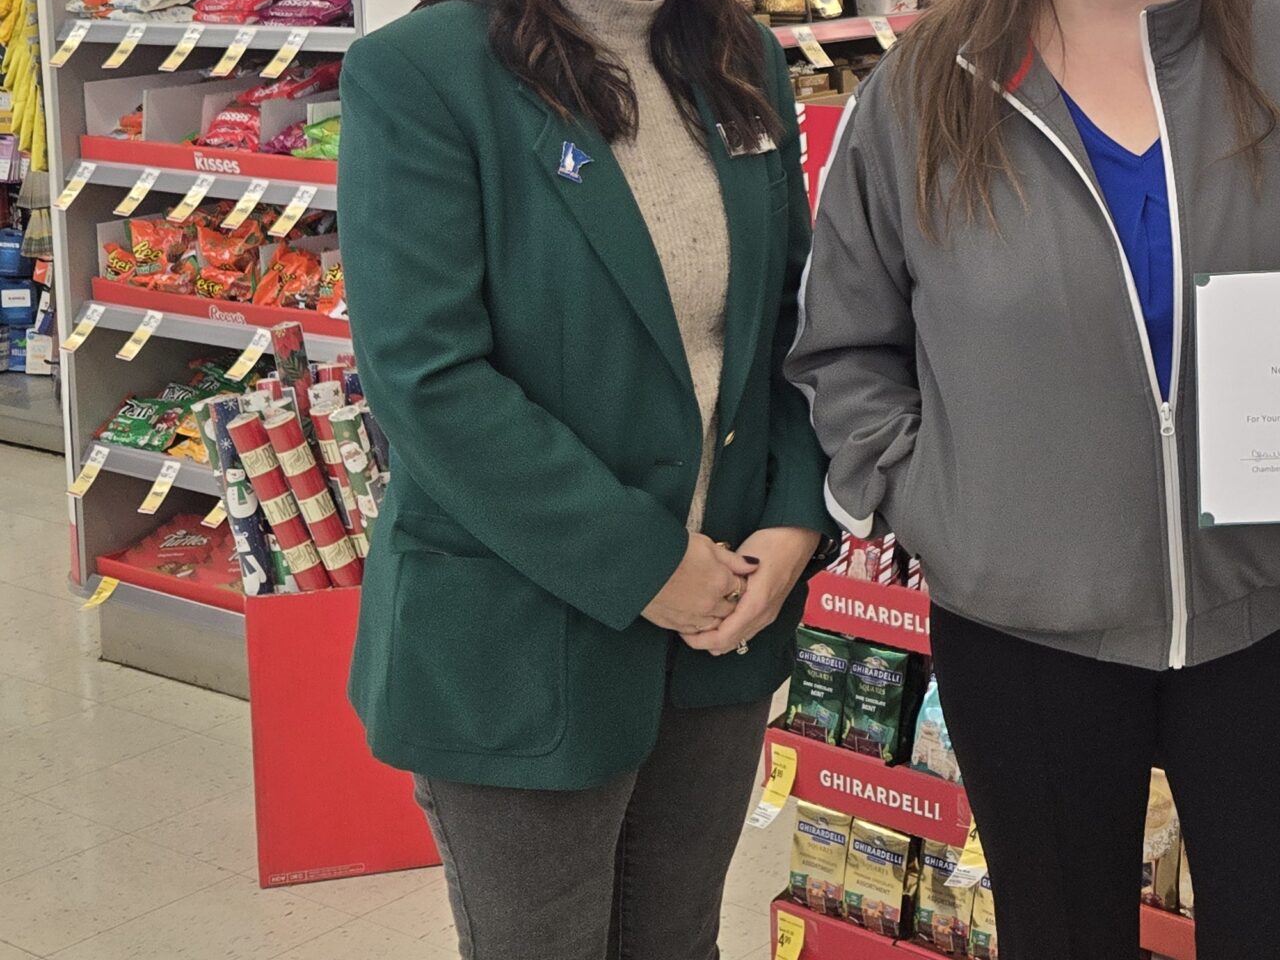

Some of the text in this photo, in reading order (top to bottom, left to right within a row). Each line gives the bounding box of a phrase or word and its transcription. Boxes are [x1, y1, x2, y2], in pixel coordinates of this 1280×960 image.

[1246, 415, 1260, 423] For
[1261, 414, 1280, 423] Your
[799, 650, 846, 670] GHIRARDELLI
[852, 664, 900, 682] GHIRARDELLI
[819, 769, 941, 820] GHIRARDELLI
[798, 822, 845, 845] GHIRARDELLI
[853, 841, 902, 865] GHIRARDELLI
